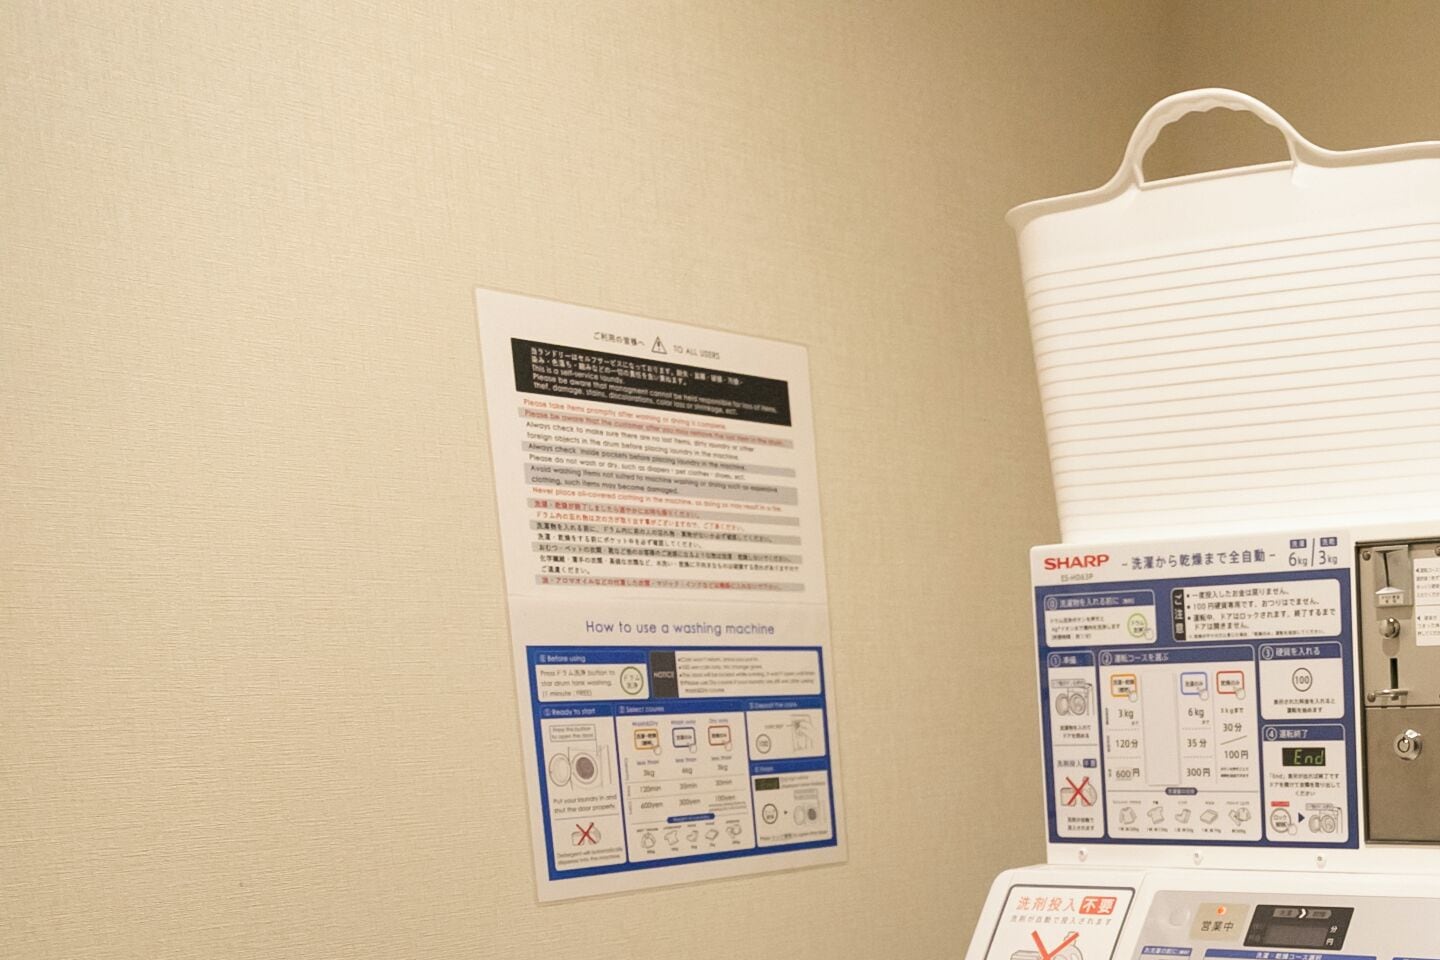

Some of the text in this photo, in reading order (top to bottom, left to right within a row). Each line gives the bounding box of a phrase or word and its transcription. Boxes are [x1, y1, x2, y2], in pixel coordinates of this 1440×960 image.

[686, 348, 699, 357] ALL
[700, 350, 721, 360] USERS
[532, 372, 608, 391] Please be aware that
[523, 398, 585, 413] Please take items
[524, 409, 548, 419] Please
[550, 412, 560, 420] be
[526, 421, 551, 431] Always
[552, 424, 574, 433] check
[585, 428, 604, 437] make
[605, 430, 619, 438] sure
[620, 430, 639, 440] there
[527, 431, 553, 443] foreign
[554, 434, 580, 445] objects
[589, 437, 602, 446] the
[603, 439, 620, 448] drum
[621, 440, 643, 450] before
[528, 442, 553, 453] Always
[554, 445, 577, 454] check
[579, 448, 600, 457] inside
[529, 453, 554, 464] Please
[555, 456, 565, 465] do
[566, 458, 578, 466] not
[579, 458, 597, 467] wash
[530, 465, 552, 474] Avoid
[553, 467, 582, 478] washing
[582, 469, 602, 479] items
[602, 471, 615, 480] not
[563, 478, 580, 487] such
[581, 479, 600, 489] items
[532, 486, 576, 498] Never place
[1044, 553, 1110, 572] SHARP
[1130, 548, 1268, 573] 洗濯から乾燥まで全自動
[1288, 552, 1308, 567] 6kg
[1318, 550, 1338, 566] 3kg
[586, 621, 775, 637] How to use a washing machine
[1295, 675, 1310, 685] 100
[1118, 709, 1134, 720] 3kg
[1187, 707, 1205, 719] 6kg
[1223, 722, 1243, 733] 30分
[1115, 738, 1139, 749] 120分
[1187, 738, 1207, 748] 35分
[1224, 750, 1249, 760] 100円
[1294, 749, 1324, 765] End
[1116, 767, 1140, 779] 600円
[1186, 767, 1211, 778] 300円
[1015, 896, 1115, 913] 洗剤投入 不要
[1200, 920, 1235, 933] 営業中
[1329, 925, 1338, 934] 分
[1325, 938, 1334, 947] 円
